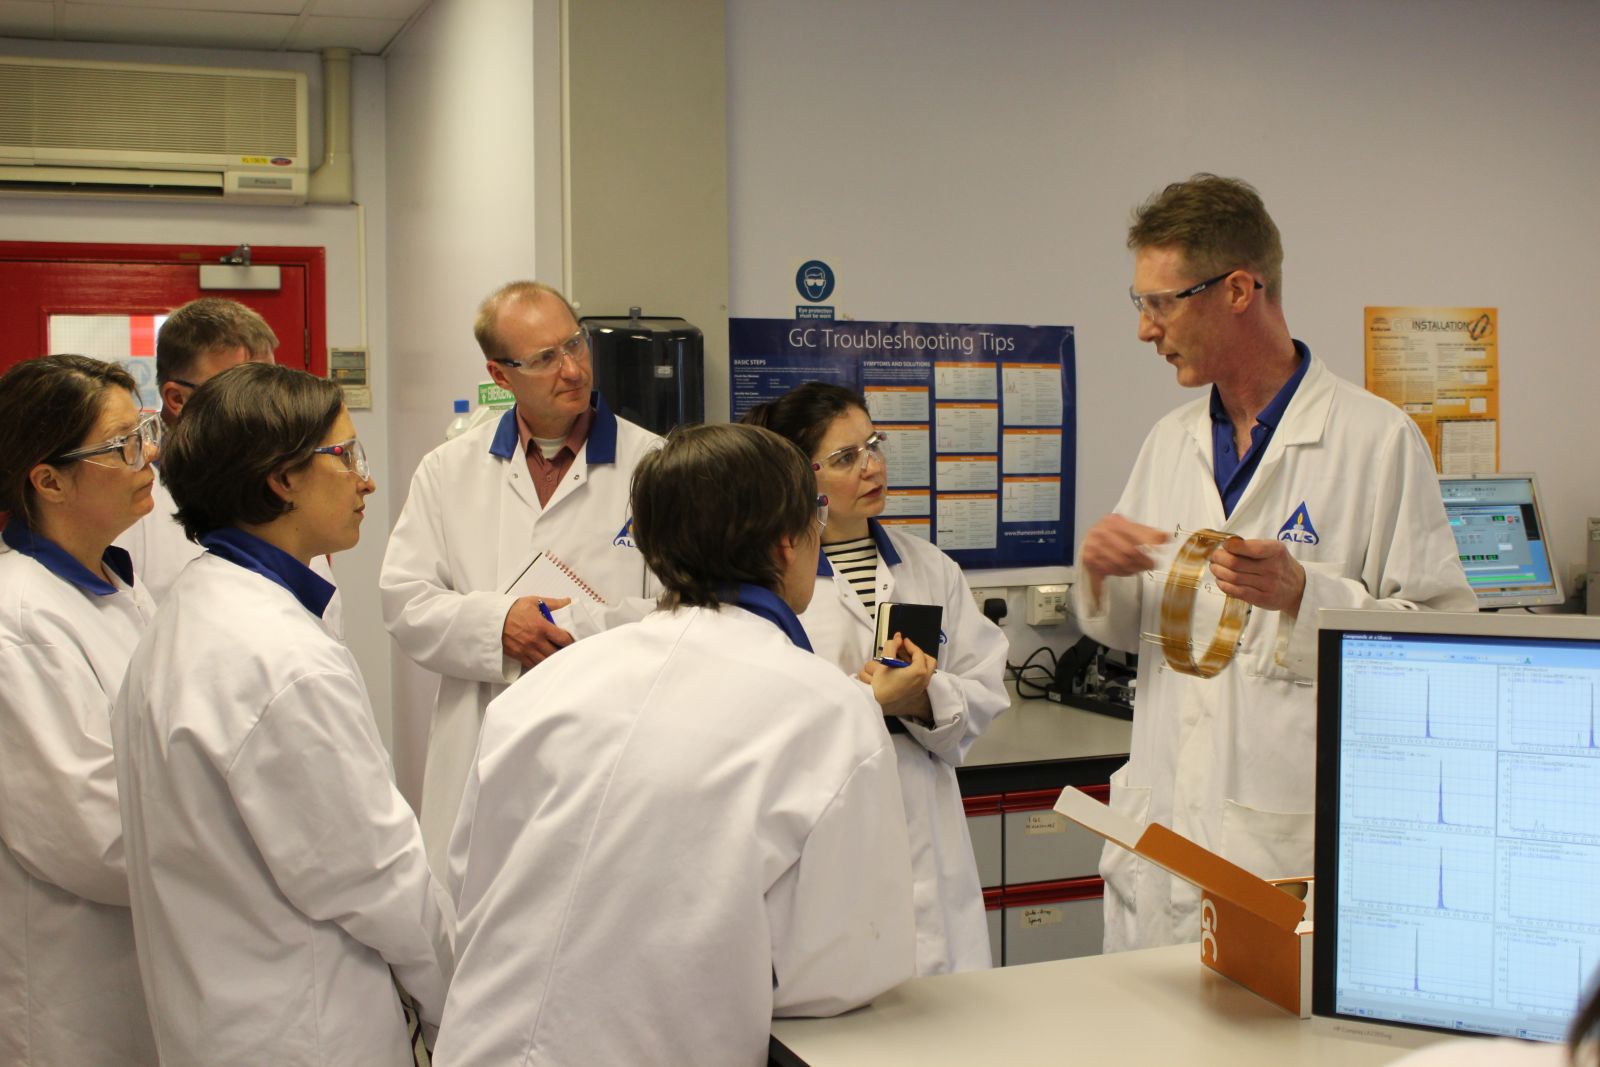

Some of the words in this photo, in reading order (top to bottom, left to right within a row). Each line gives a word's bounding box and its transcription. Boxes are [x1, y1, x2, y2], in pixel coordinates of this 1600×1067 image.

[1412, 320, 1469, 331] INSTALLATION
[788, 328, 817, 348] GC
[821, 329, 974, 355] Troubleshooting
[978, 332, 1015, 355] Tips
[1281, 532, 1314, 544] ALS
[1201, 898, 1218, 963] GC
